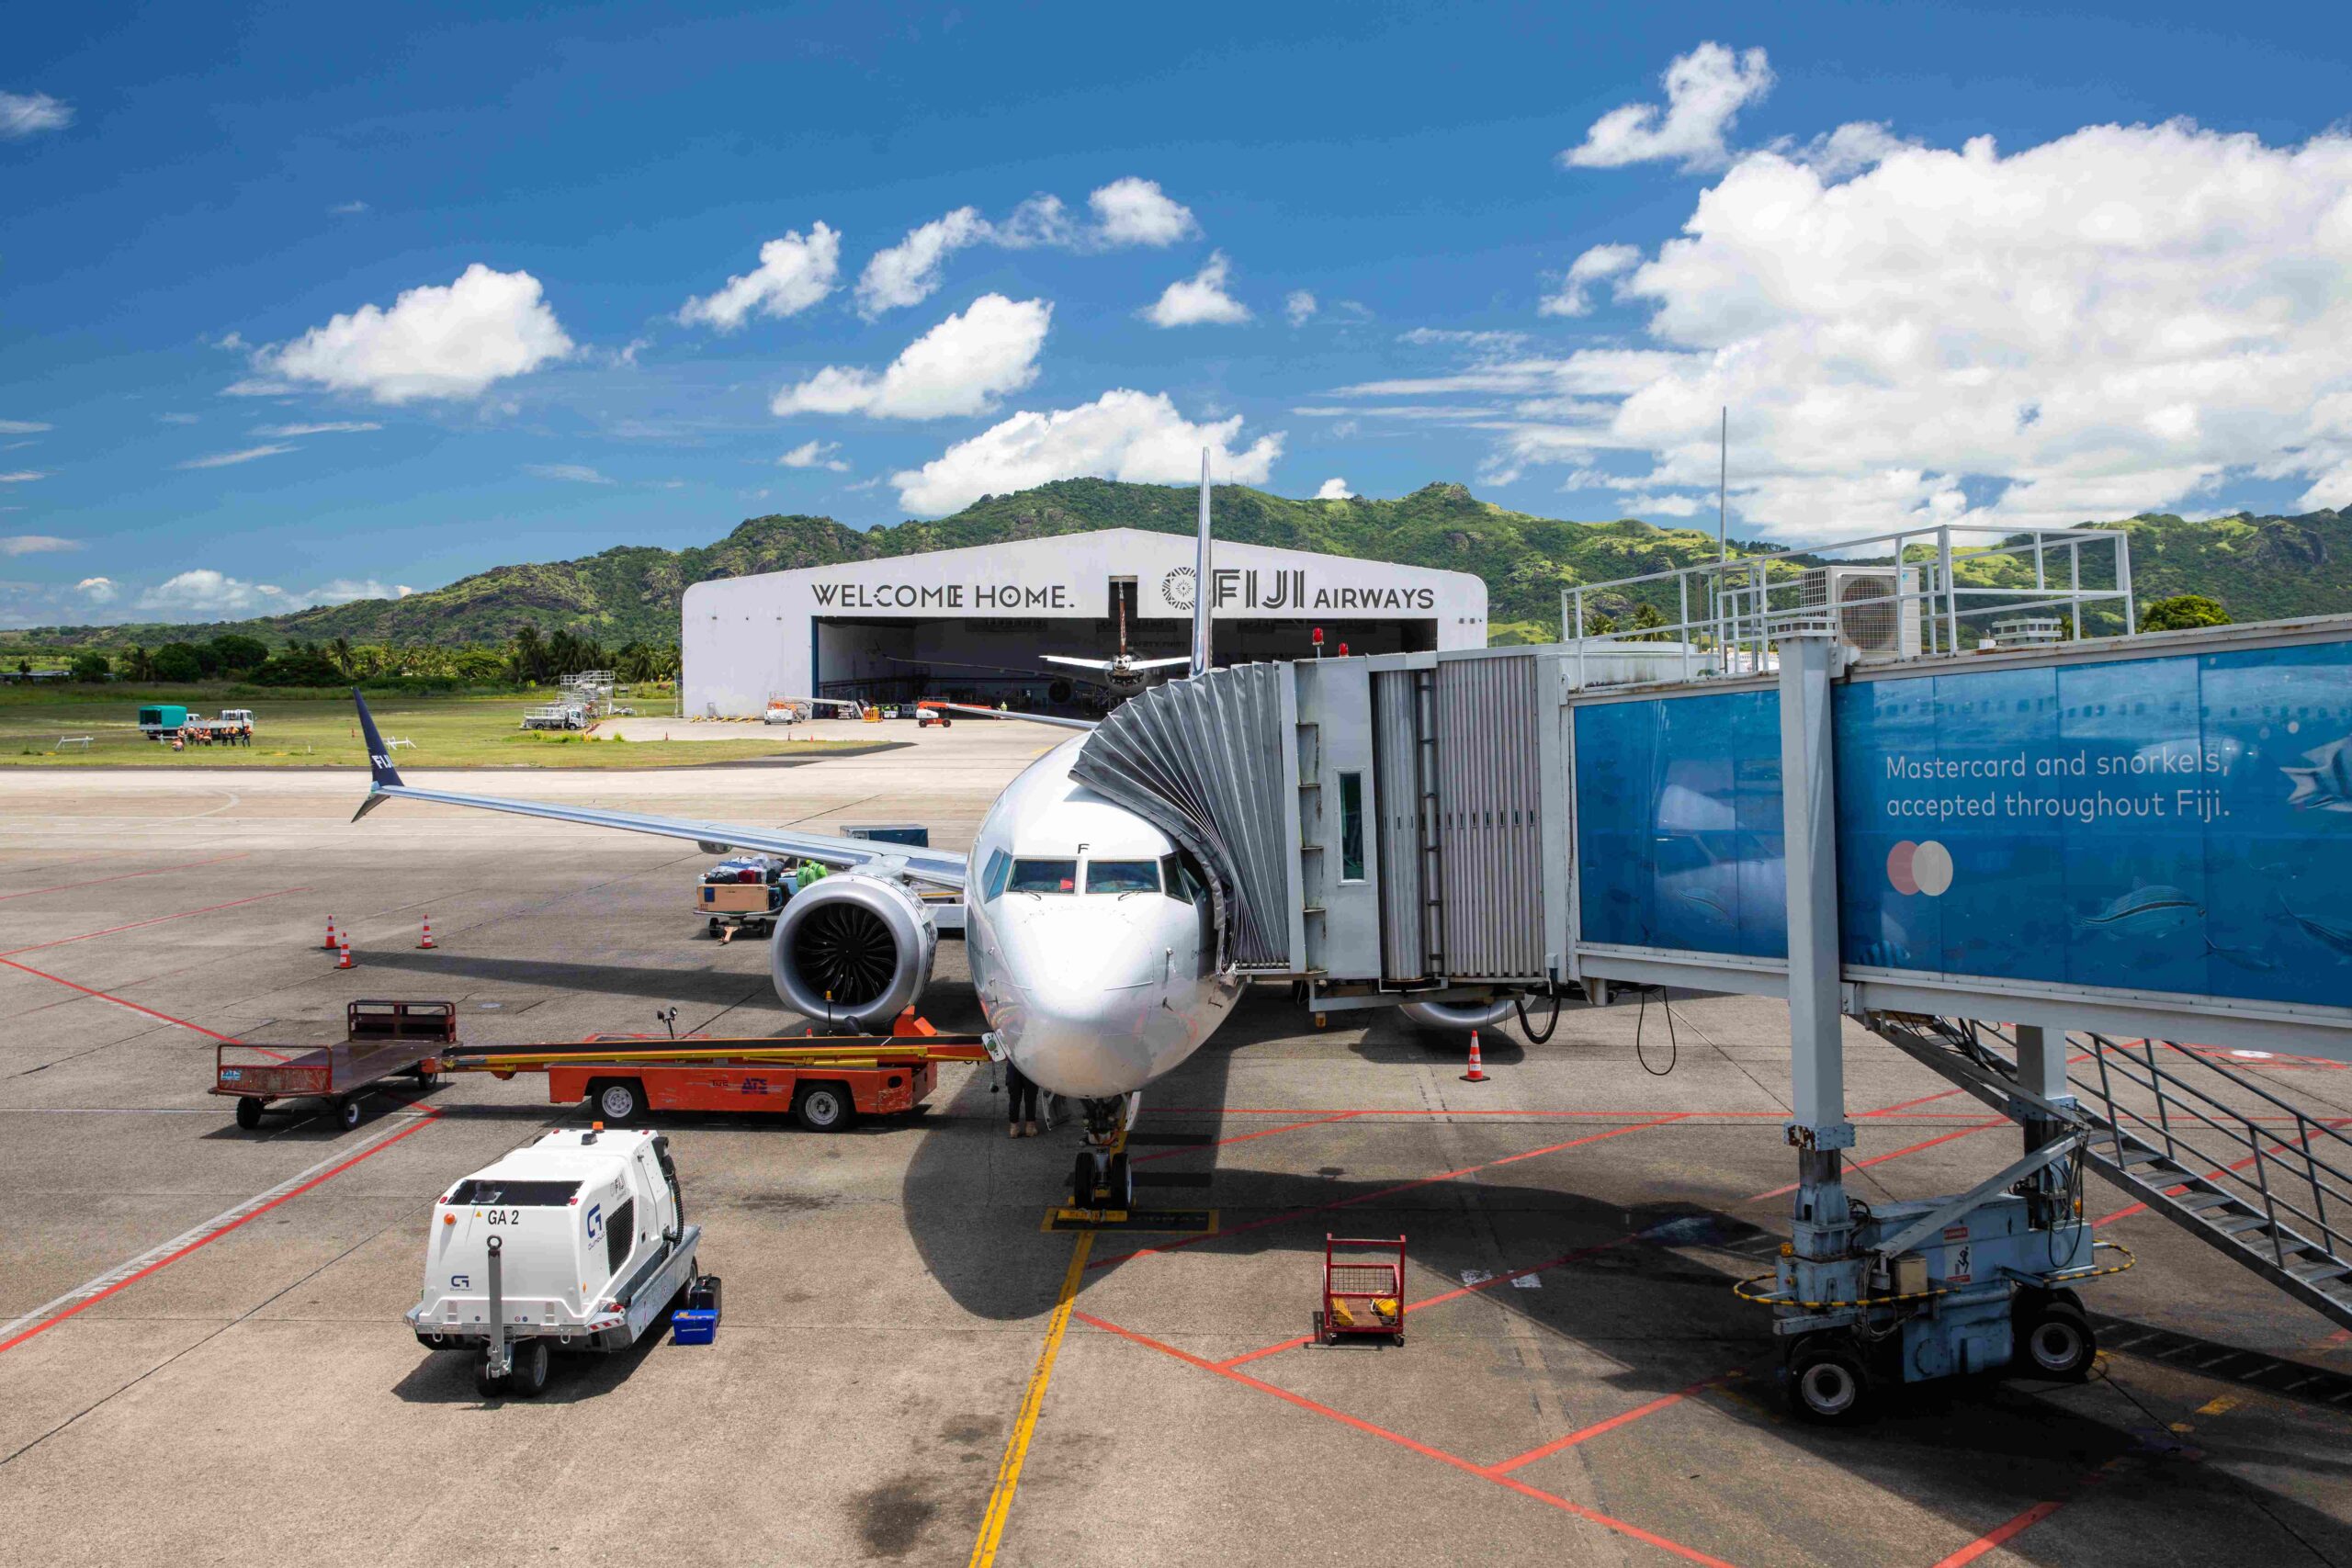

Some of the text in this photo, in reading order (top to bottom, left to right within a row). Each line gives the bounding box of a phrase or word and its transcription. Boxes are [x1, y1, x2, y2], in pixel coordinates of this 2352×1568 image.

[811, 584, 1075, 608] WELCOME HOME.
[1212, 569, 1434, 609] FIJI AIRWAYS
[1886, 745, 2229, 779] Mastercard and snorkels,
[1886, 789, 2231, 823] accepted throughout Fiji.
[1077, 843, 1091, 854] F
[488, 1209, 520, 1225] GA 2
